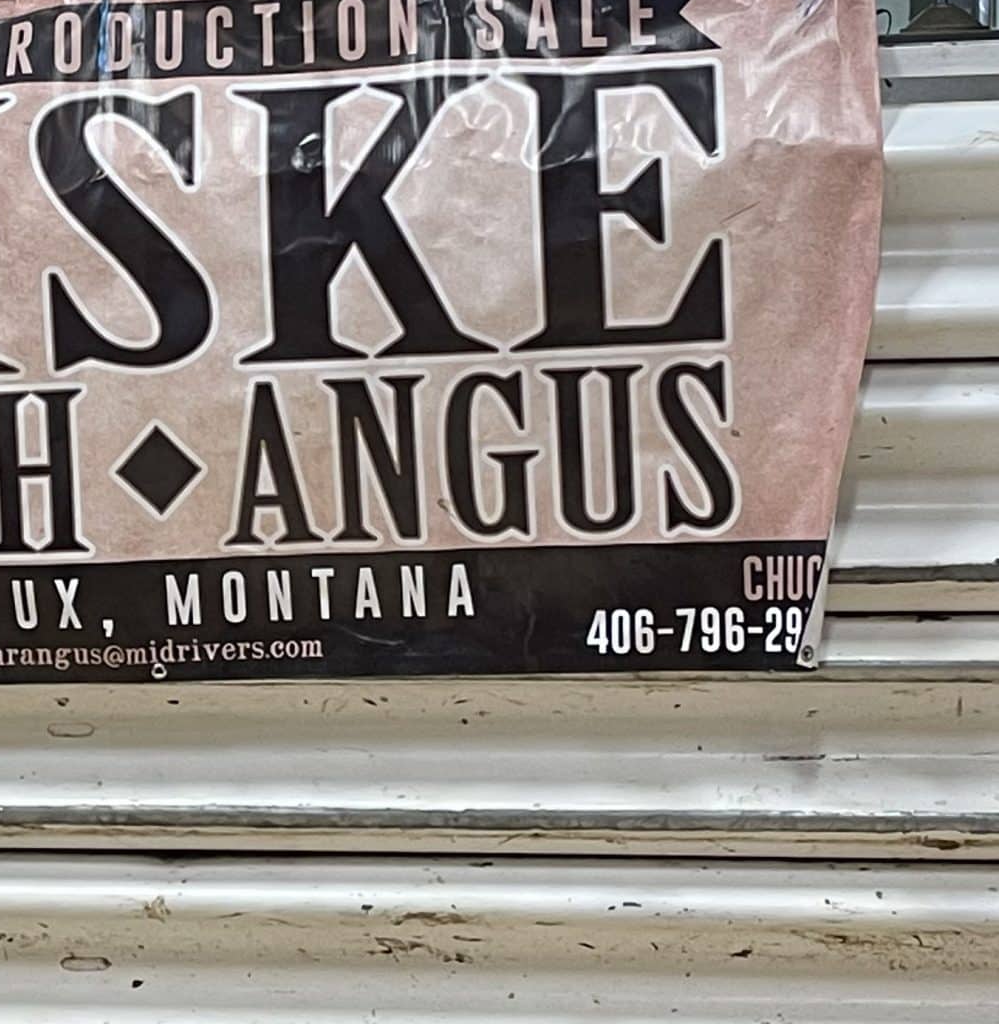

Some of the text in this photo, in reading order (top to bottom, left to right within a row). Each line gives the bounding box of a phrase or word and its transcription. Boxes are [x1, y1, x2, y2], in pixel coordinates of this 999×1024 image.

[220, 354, 742, 552] ANGUS
[165, 562, 476, 627] MONTANA
[585, 604, 808, 655] 406-796-29
